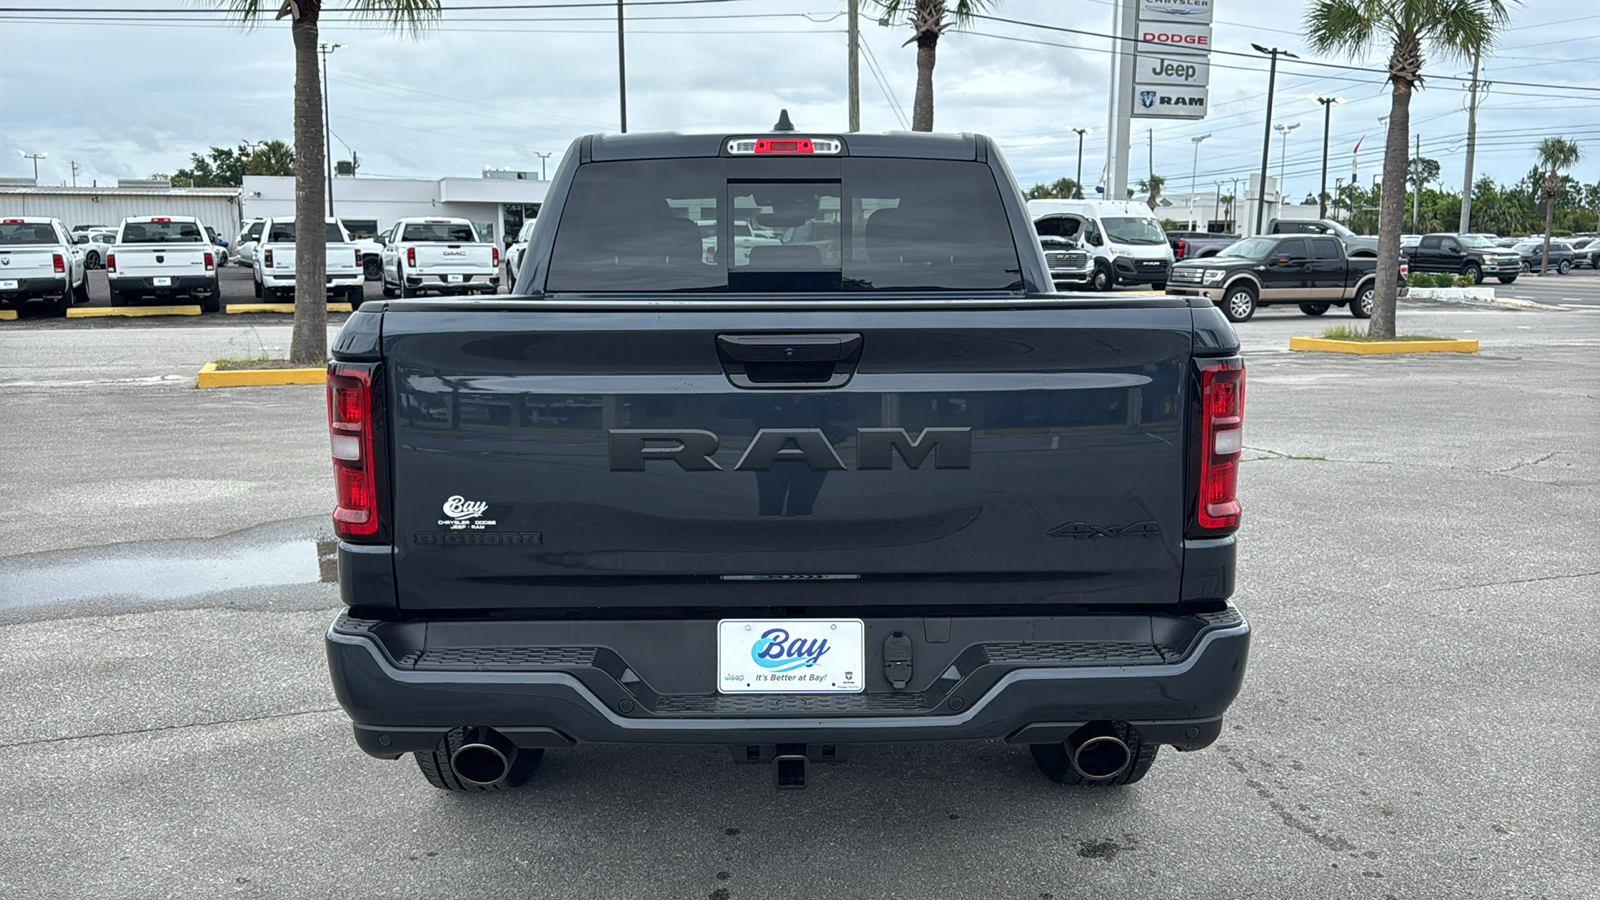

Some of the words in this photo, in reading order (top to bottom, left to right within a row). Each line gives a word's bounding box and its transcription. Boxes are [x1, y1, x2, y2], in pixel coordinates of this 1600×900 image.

[1143, 33, 1208, 45] DODGE
[1152, 58, 1196, 81] Jeep
[1159, 96, 1204, 106] RAM
[608, 427, 972, 472] RAM
[444, 495, 489, 518] Bay
[757, 628, 831, 668] Bay
[755, 674, 768, 682] It's
[770, 674, 796, 682] Better
[798, 674, 807, 682] at
[808, 674, 828, 682] Bay!
